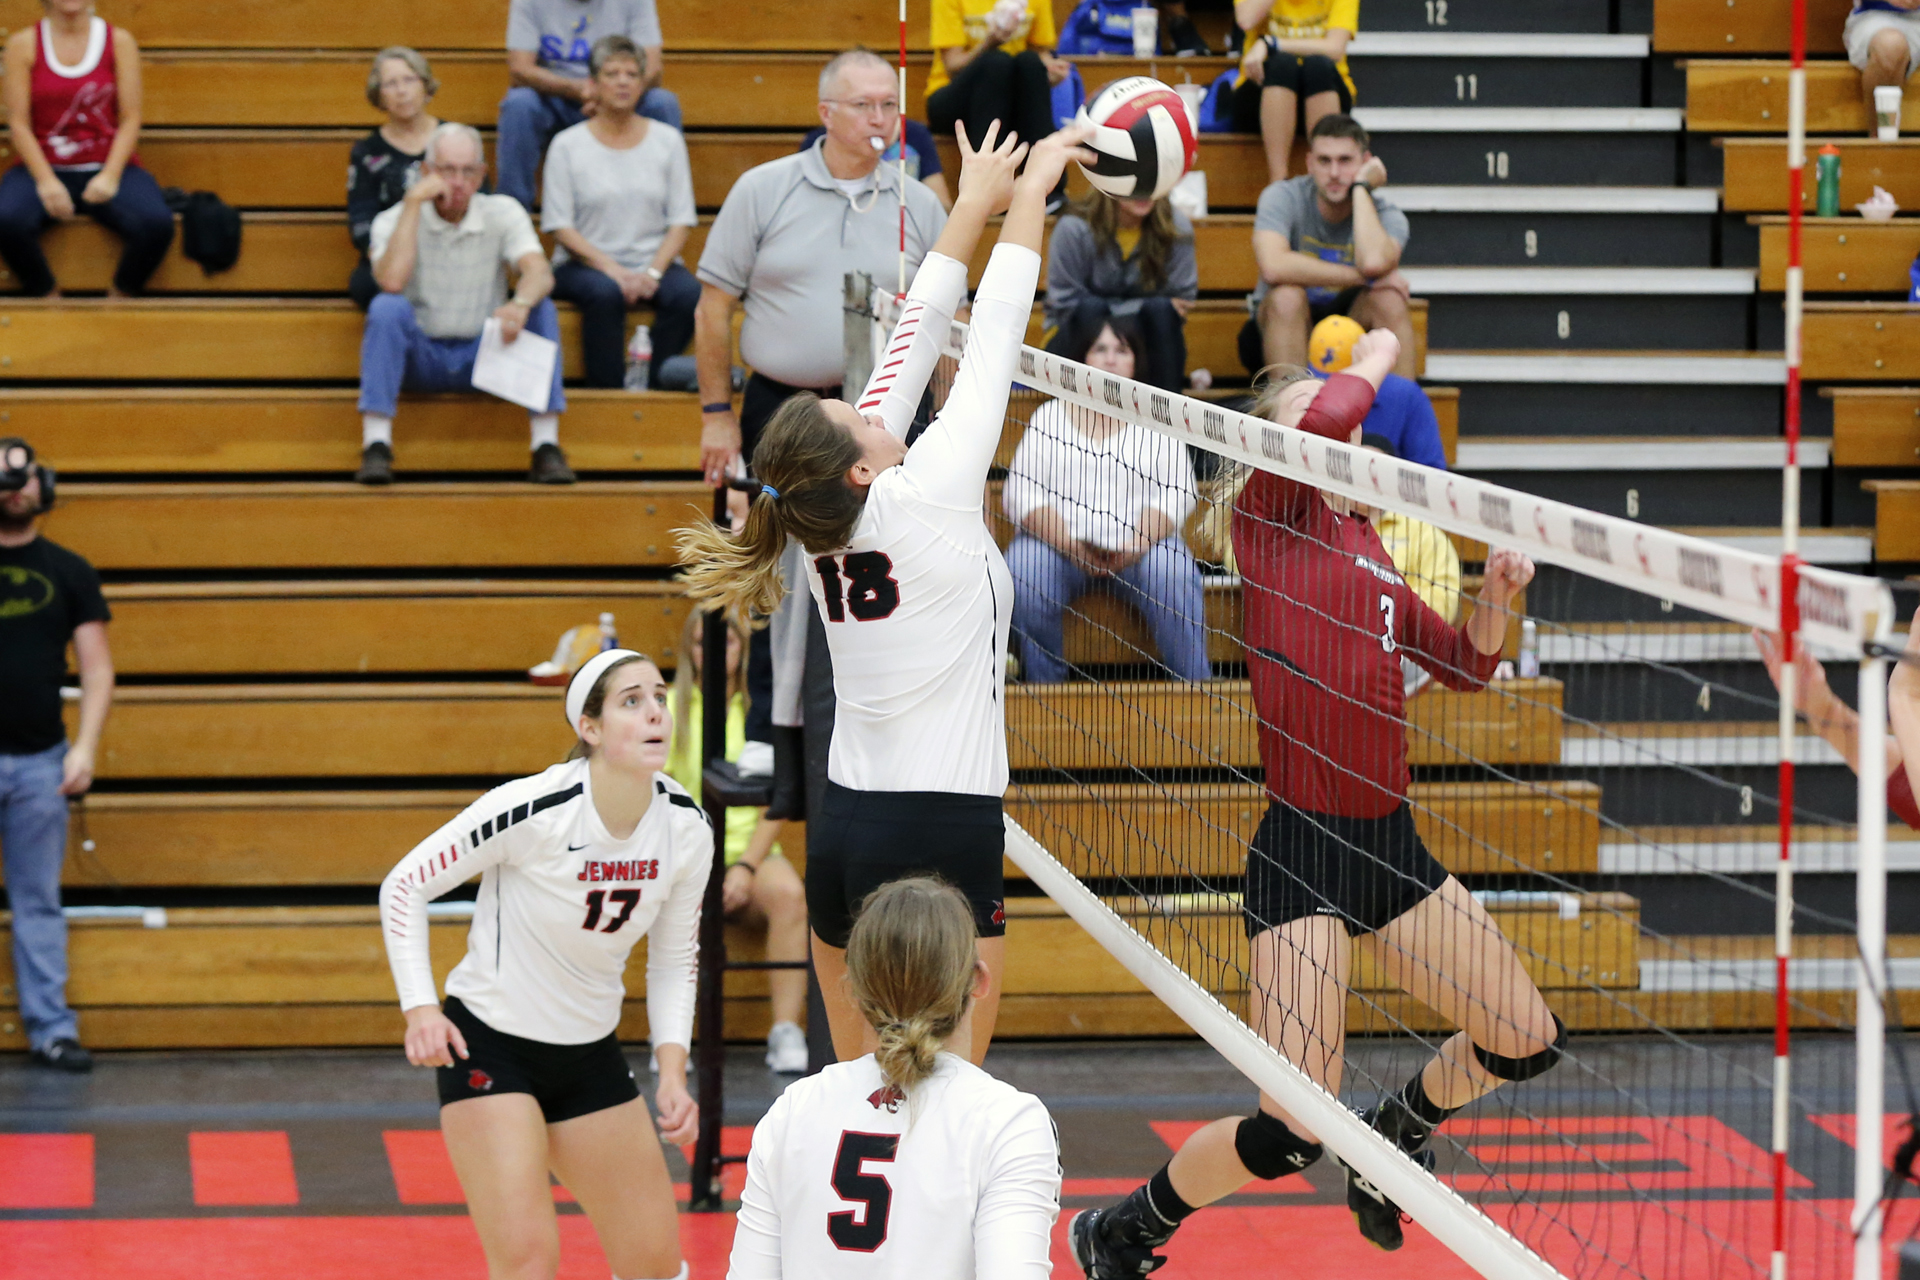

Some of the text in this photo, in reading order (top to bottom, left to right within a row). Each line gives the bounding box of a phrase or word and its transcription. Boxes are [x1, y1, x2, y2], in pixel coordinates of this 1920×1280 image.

[1425, 0, 1448, 26] 12
[540, 35, 590, 60] SA
[1455, 74, 1478, 100] 11
[1486, 151, 1509, 179] 10
[1525, 229, 1538, 258] 9
[1557, 310, 1570, 339] 8
[1626, 488, 1640, 518] 6
[814, 550, 900, 623] 18
[1380, 593, 1396, 654] 3
[1696, 682, 1711, 712] 4
[1740, 785, 1753, 817] 3
[577, 859, 659, 881] JENNIES
[582, 888, 641, 934] 17
[827, 1129, 901, 1253] 5
